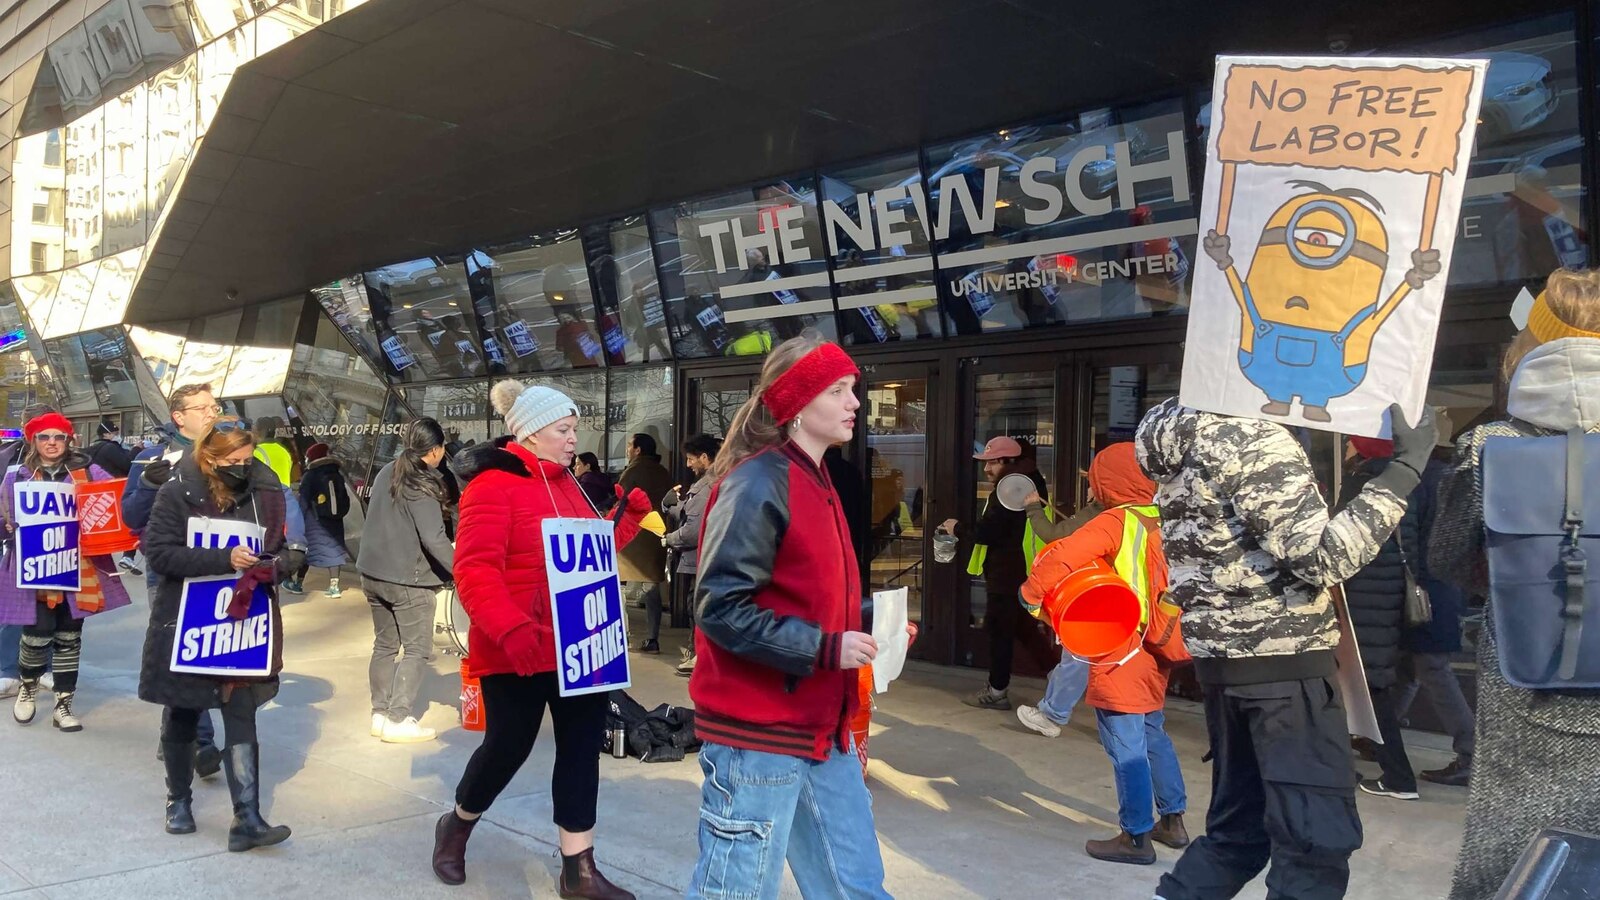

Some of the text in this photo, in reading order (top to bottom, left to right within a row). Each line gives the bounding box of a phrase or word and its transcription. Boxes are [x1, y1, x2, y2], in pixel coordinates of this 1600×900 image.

[1249, 79, 1443, 118] NO FREE
[1249, 120, 1428, 159] LABOR!
[698, 130, 1190, 274] THE NEW SCH
[950, 267, 1074, 297] UNIVERSITY
[1081, 253, 1179, 282] CENTER
[355, 424, 369, 435] OF
[370, 423, 409, 437] FASCIS
[19, 491, 77, 518] UAW
[42, 527, 66, 551] ON
[549, 534, 613, 573] UAW
[24, 548, 78, 582] STRIKE
[214, 586, 233, 620] O
[583, 586, 608, 631] ON
[181, 613, 268, 661] STRIKE
[564, 623, 625, 683] STRIKE
